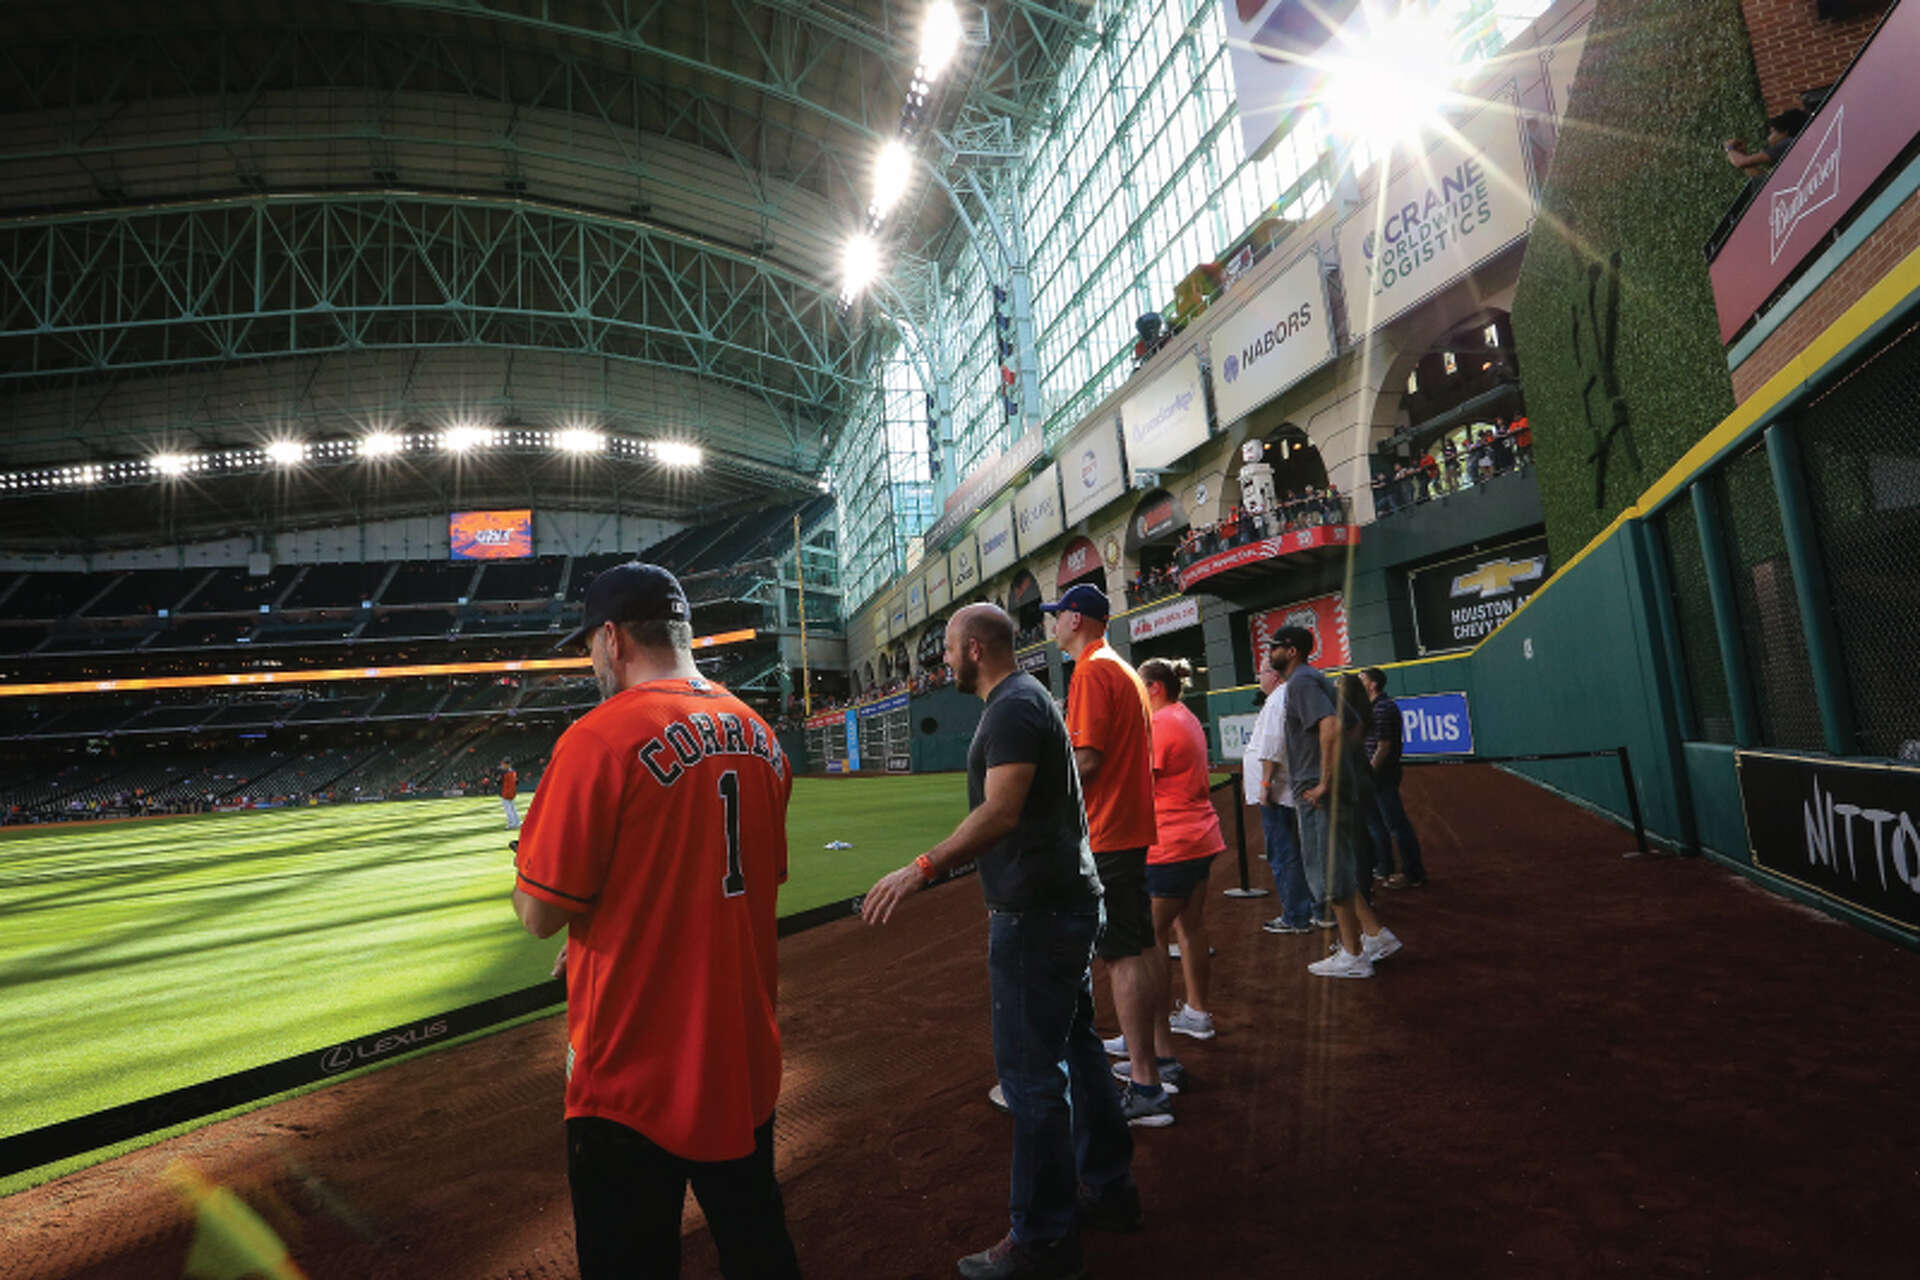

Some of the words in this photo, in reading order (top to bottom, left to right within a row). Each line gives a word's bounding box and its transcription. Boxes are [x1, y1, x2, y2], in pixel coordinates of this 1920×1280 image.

[1384, 157, 1483, 243] CRANE
[1242, 302, 1311, 370] NABORS
[1451, 599, 1512, 624] HOUSTON
[1453, 619, 1494, 639] CHEVY
[718, 770, 746, 898] 1
[1804, 773, 1920, 893] NITTO
[357, 1020, 448, 1057] LEXUS
